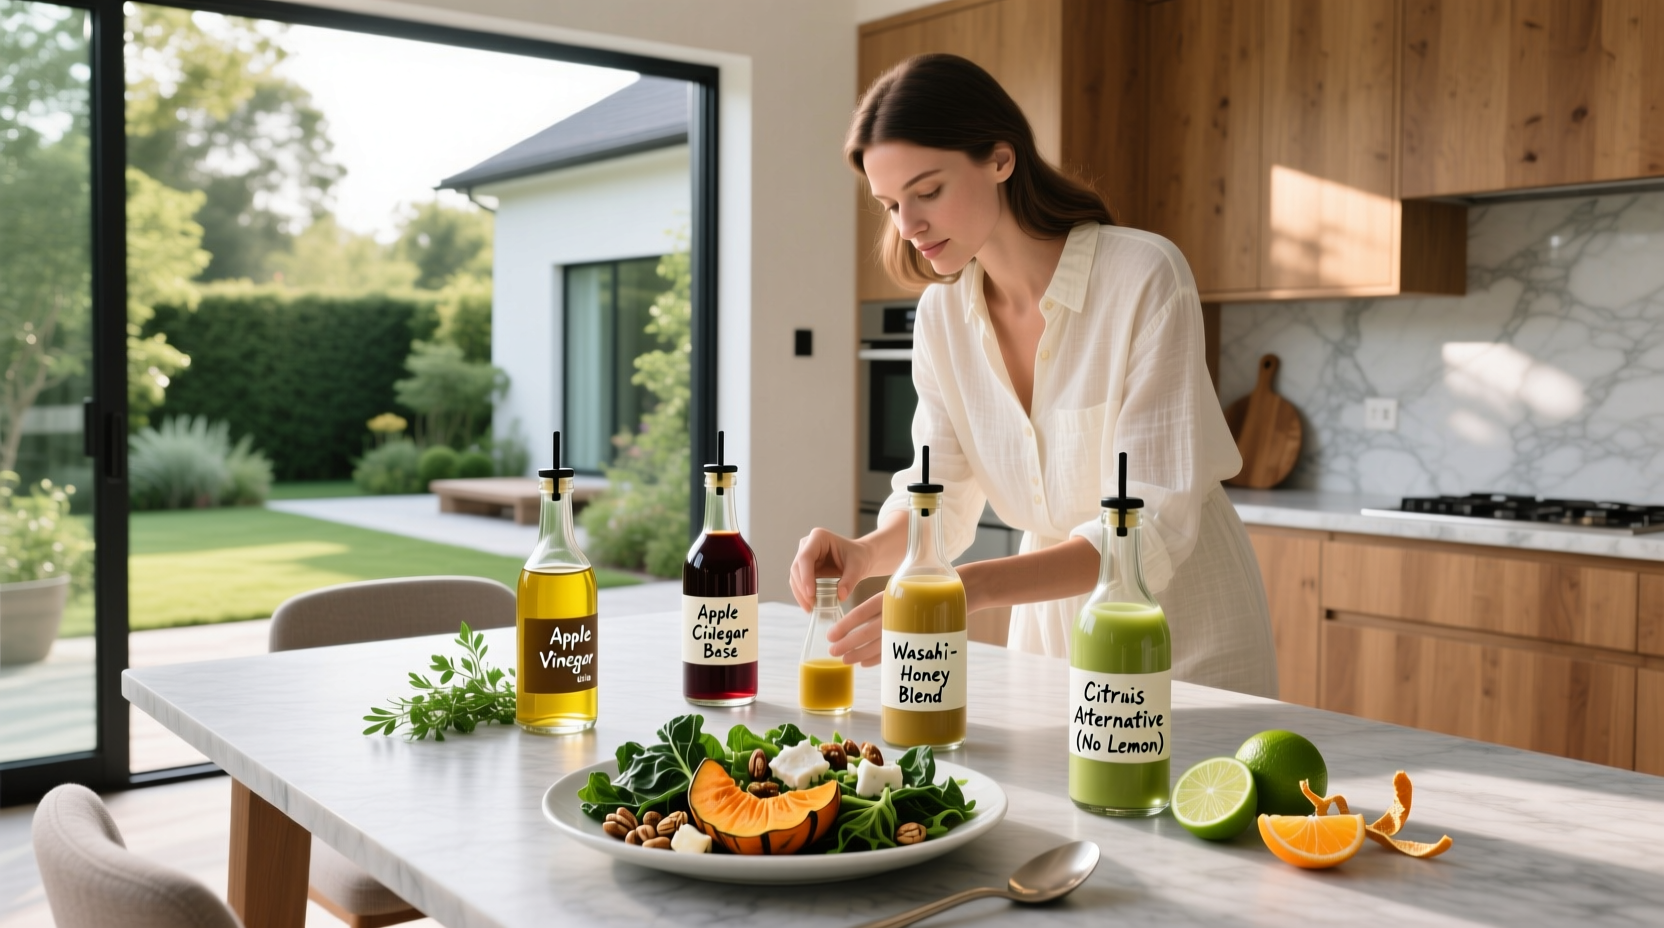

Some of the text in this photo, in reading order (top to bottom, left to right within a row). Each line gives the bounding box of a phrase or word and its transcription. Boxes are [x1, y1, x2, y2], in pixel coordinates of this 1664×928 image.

[698, 603, 738, 625] Apple
[549, 624, 591, 651] Apple
[704, 643, 738, 659] Base
[901, 664, 950, 688] Honey
[899, 685, 943, 703] Blend
[1076, 729, 1164, 755] (No Lemon)
